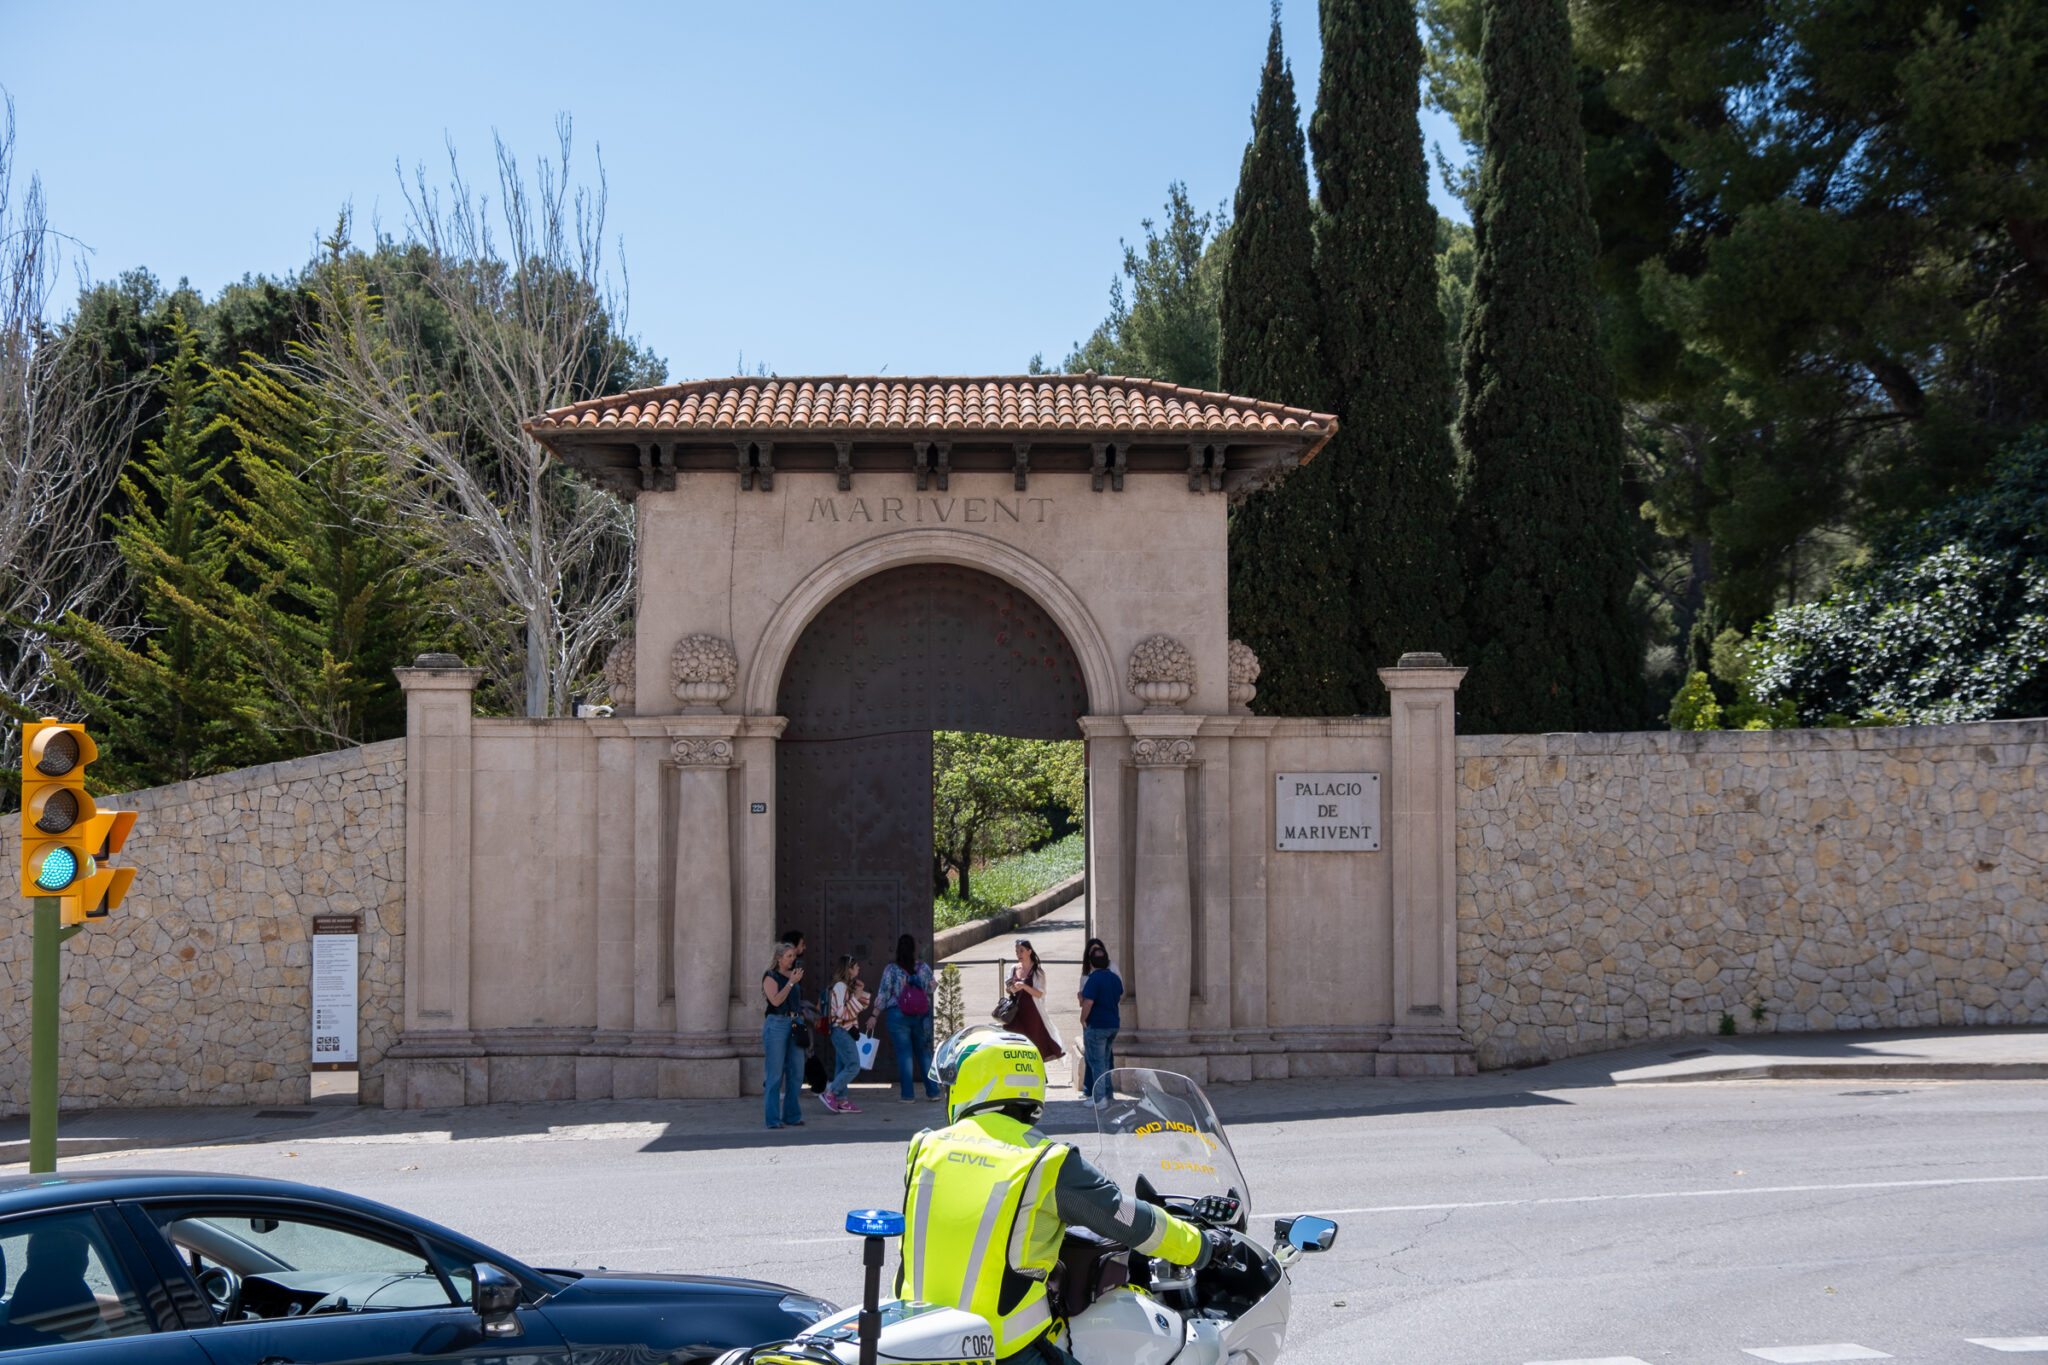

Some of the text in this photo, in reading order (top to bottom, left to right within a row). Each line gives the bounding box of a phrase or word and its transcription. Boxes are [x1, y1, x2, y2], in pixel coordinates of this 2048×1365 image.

[807, 497, 1055, 523] MARIVENT
[1295, 782, 1362, 796] PALACIO
[1317, 804, 1339, 818] DE
[1284, 826, 1372, 839] MARIVENT
[1003, 1050, 1039, 1060] GUARDIA
[1015, 1063, 1034, 1073] CIVIL
[937, 1132, 1023, 1154] GUARDIA
[947, 1151, 996, 1168] CIVIL
[972, 1335, 995, 1356] 062
